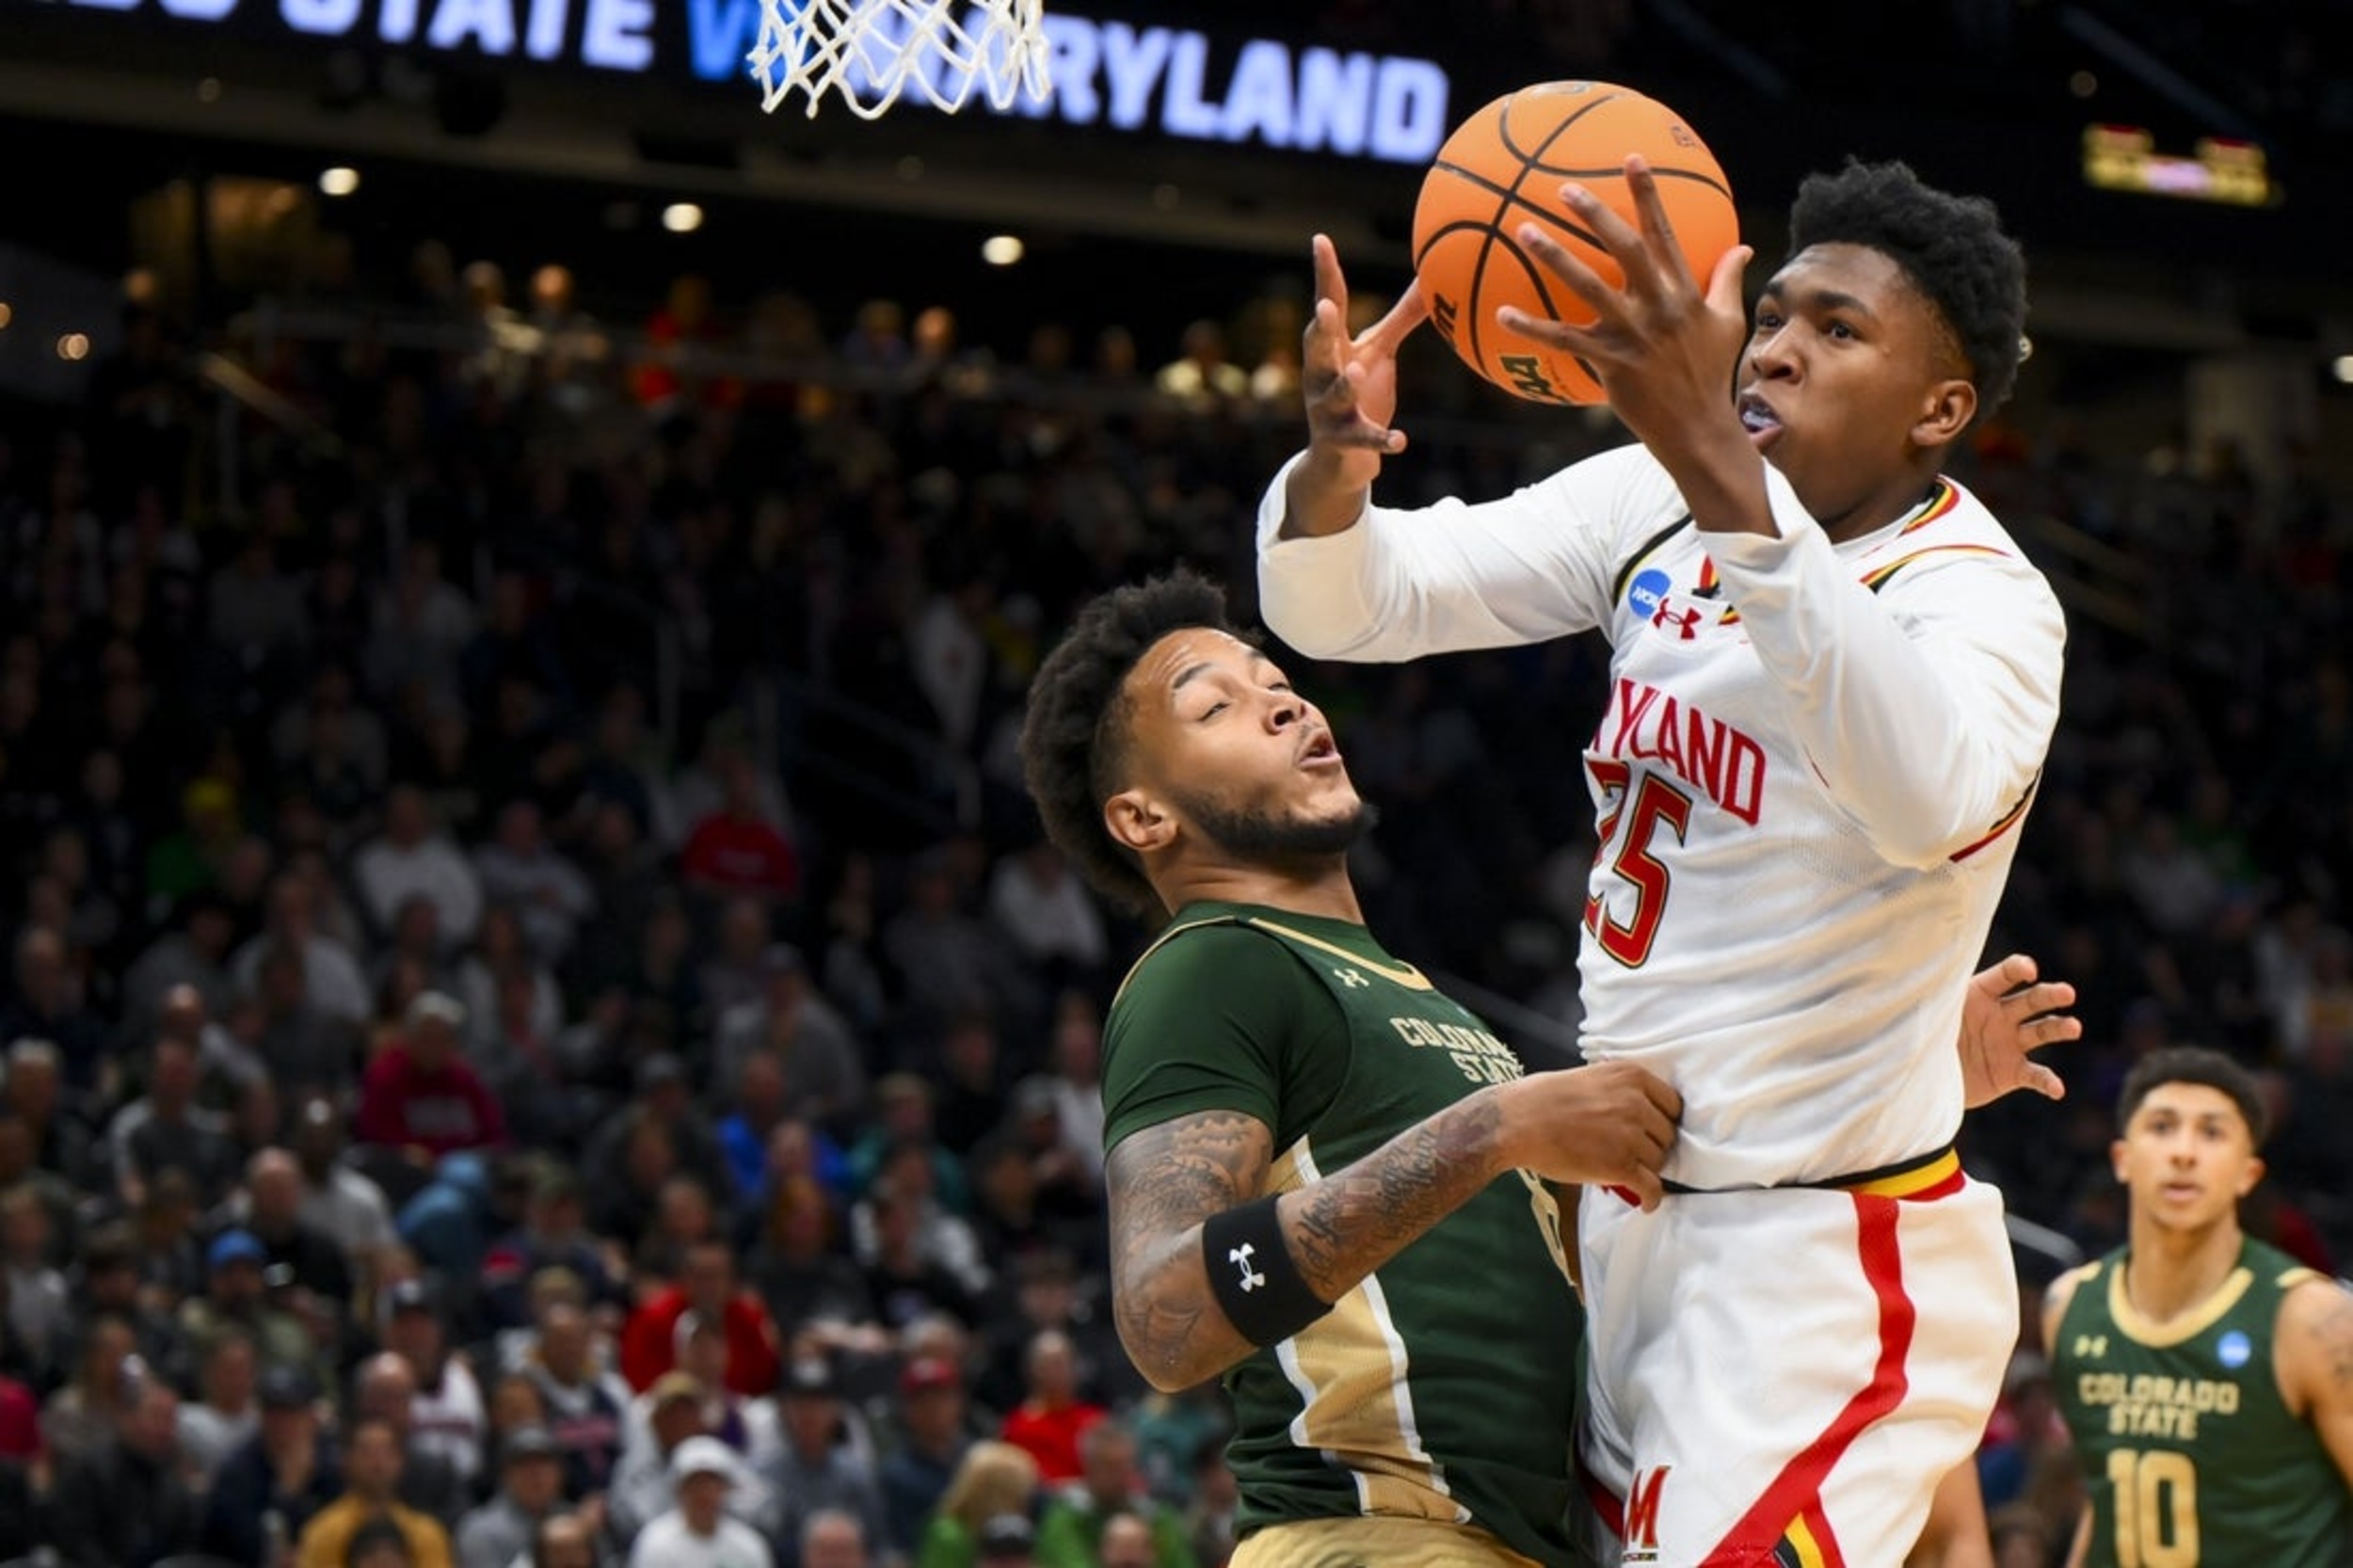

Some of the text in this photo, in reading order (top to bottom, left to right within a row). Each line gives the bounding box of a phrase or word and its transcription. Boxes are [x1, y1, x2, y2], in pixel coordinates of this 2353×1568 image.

[844, 0, 1450, 163] MARYLAND
[1388, 1016, 1518, 1065] COLORA
[2078, 1373, 2240, 1416] COLORADO
[2108, 1404, 2199, 1441] STATE
[2106, 1448, 2200, 1568] 10
